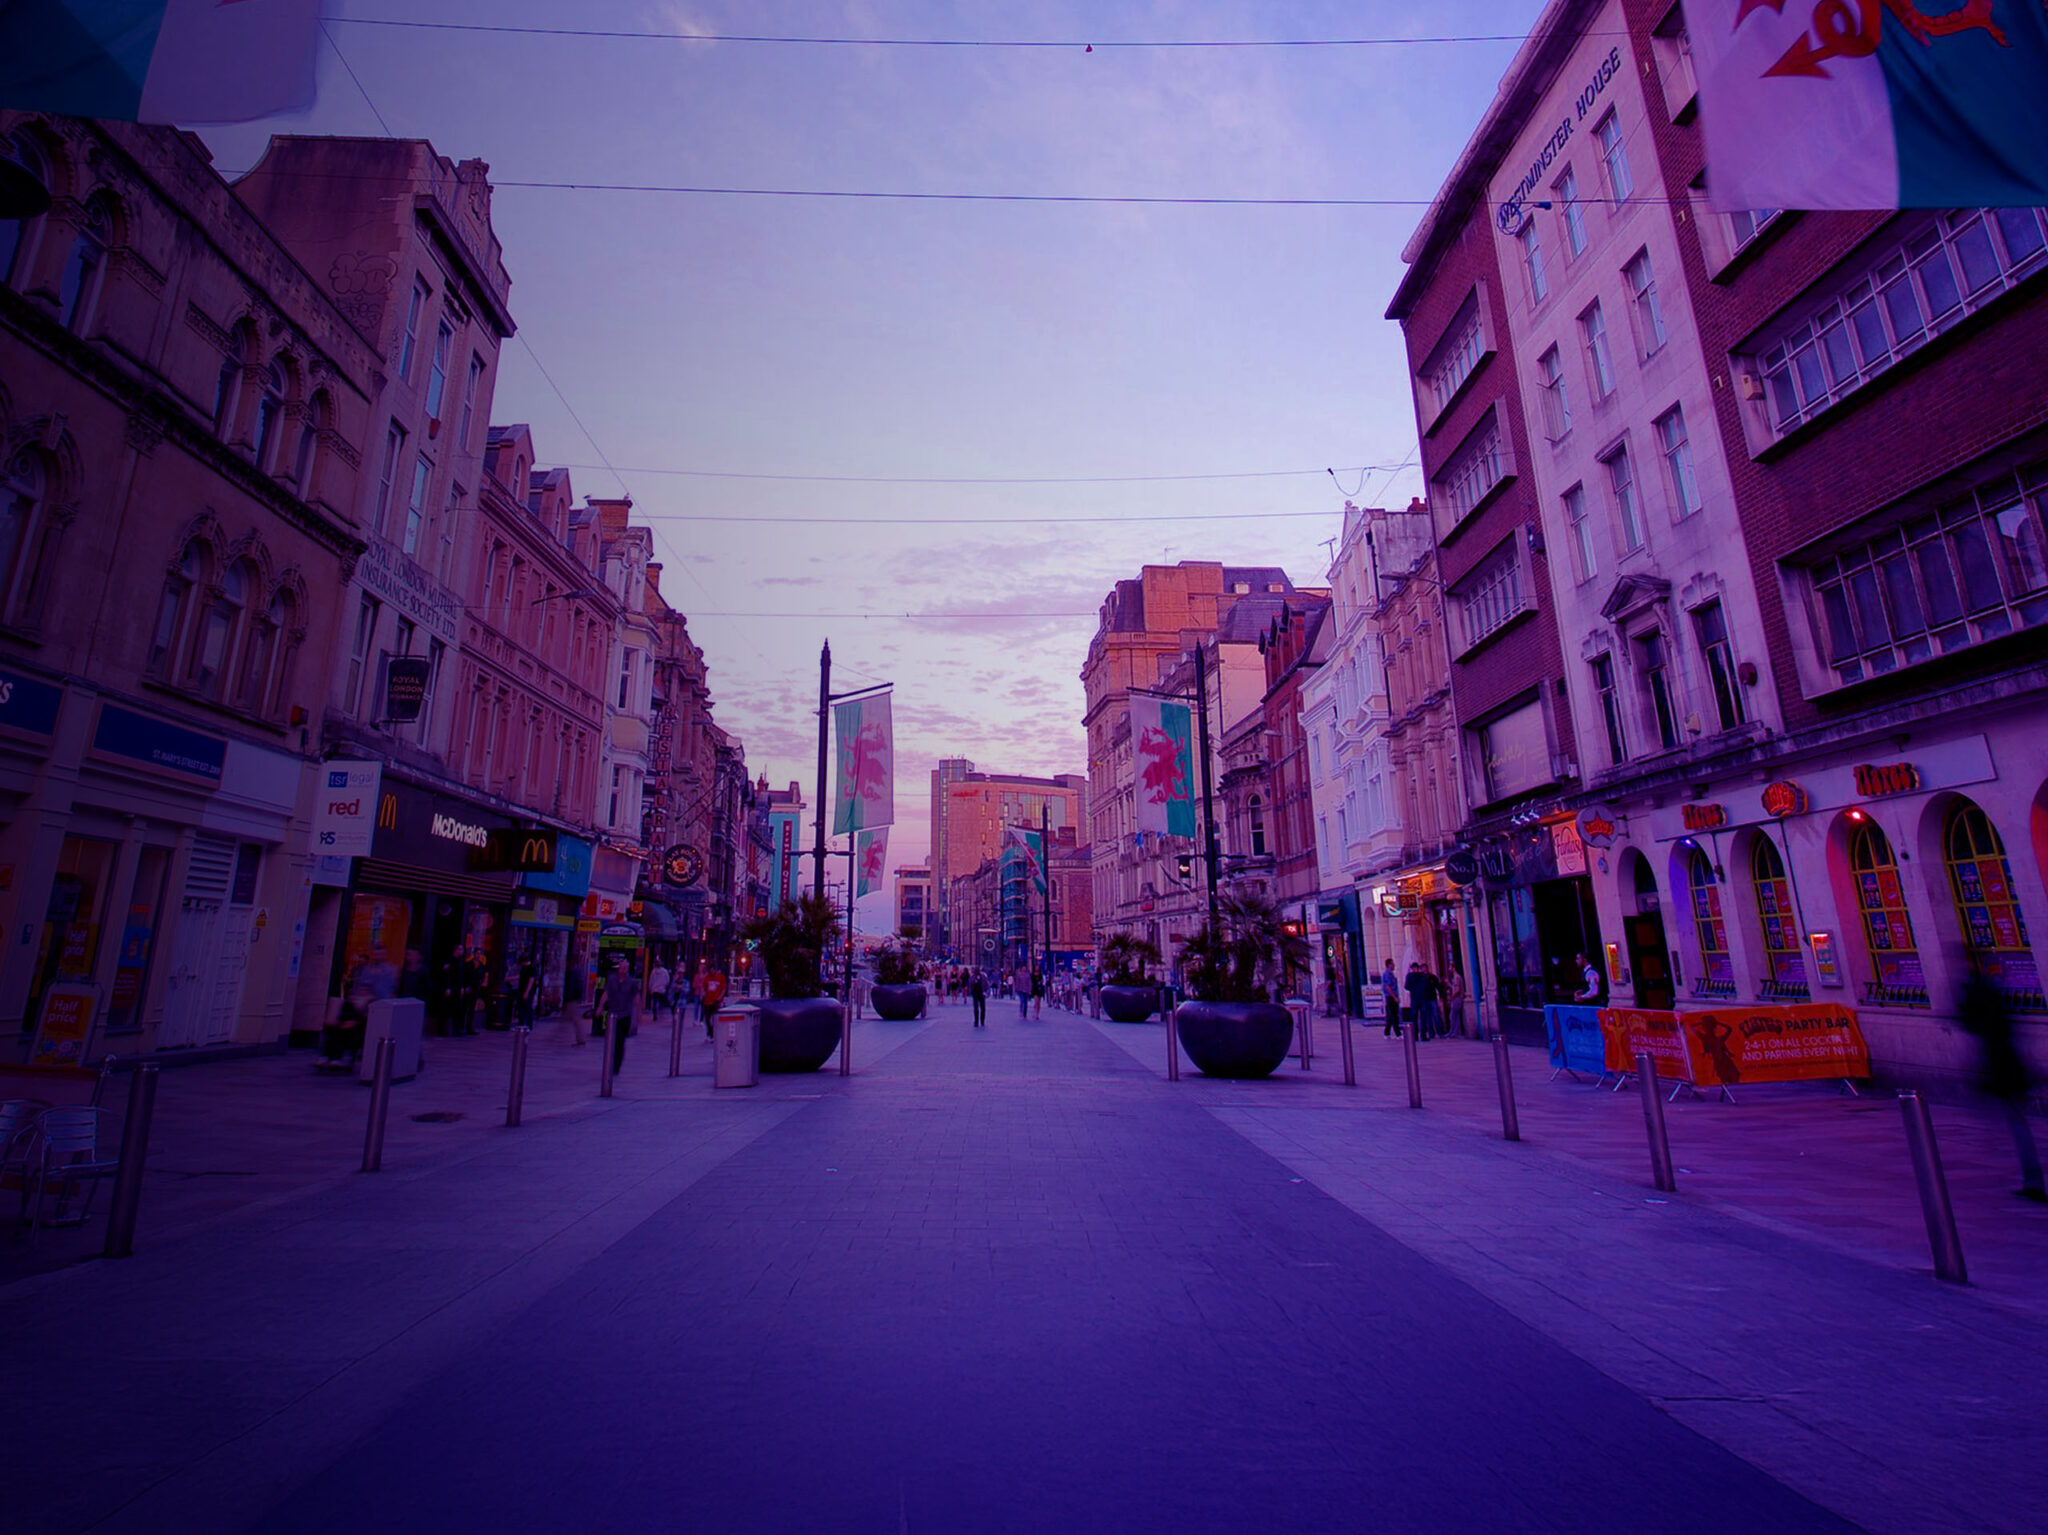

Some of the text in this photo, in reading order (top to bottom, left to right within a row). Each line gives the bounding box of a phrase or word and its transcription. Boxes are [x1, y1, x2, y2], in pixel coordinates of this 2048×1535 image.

[1500, 46, 1622, 227] WESTMINSTER HOUSE
[366, 535, 458, 620] ROYAL LONDON MUTUAL
[361, 559, 409, 607] INSURANCE
[409, 595, 442, 630] SOCIETY
[392, 675, 420, 684] ROYAL
[390, 684, 423, 693] LONDON
[329, 771, 374, 786] tsr legal
[649, 706, 675, 884] RESTAURANT
[328, 799, 360, 816] red
[431, 813, 488, 848] McDonald's
[1449, 862, 1476, 874] No.1
[1481, 849, 1507, 877] No.1
[53, 999, 80, 1012] Half
[47, 1012, 78, 1027] price
[1784, 1018, 1822, 1031] PARTY
[1825, 1017, 1850, 1028] BAR
[1768, 1039, 1784, 1049] ON
[1785, 1037, 1801, 1047] ALL
[1742, 1051, 1763, 1062] AND
[1803, 1045, 1830, 1058] EVERY
[1832, 1045, 1858, 1057] NIHT
